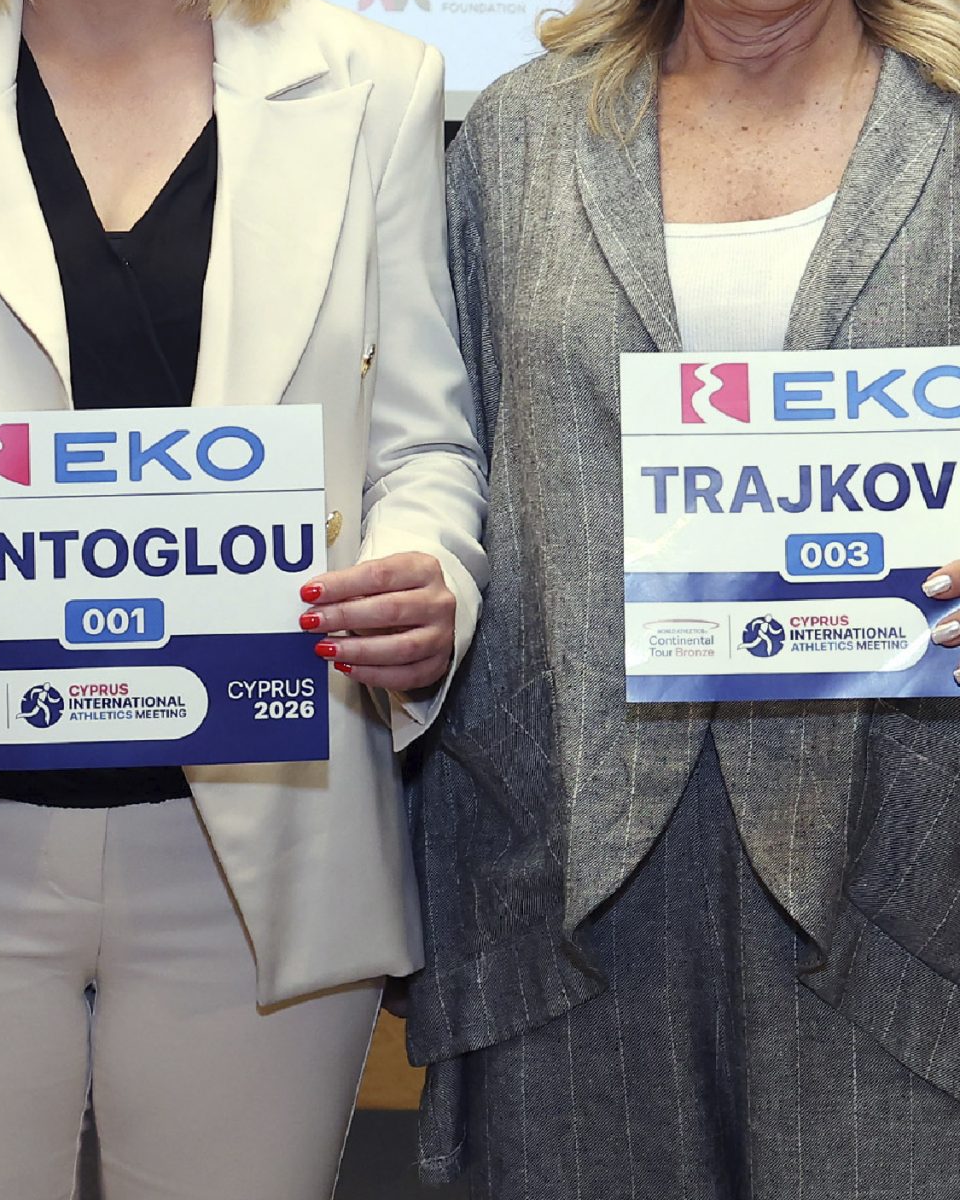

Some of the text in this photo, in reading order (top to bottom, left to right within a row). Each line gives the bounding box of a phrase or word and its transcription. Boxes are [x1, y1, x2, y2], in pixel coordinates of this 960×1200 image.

[442, 2, 527, 14] FOUNDATION
[773, 364, 960, 422] EKO
[54, 425, 266, 485] EKO
[640, 460, 958, 515] TRAJKOV
[800, 541, 870, 570] 003
[82, 607, 145, 635] 001
[790, 615, 850, 628] CYPRUS
[649, 635, 715, 646] Continental
[789, 627, 907, 641] INTERNATIONAL
[649, 647, 715, 657] Tour Bronze
[791, 639, 909, 652] ATHLETICS MEETING
[68, 682, 129, 698] CYPRUS
[226, 678, 316, 700] CYPRUS
[68, 695, 186, 710] INTERNATIONAL
[69, 708, 187, 721] ATHLETICS MEETING
[253, 701, 316, 720] 2026
